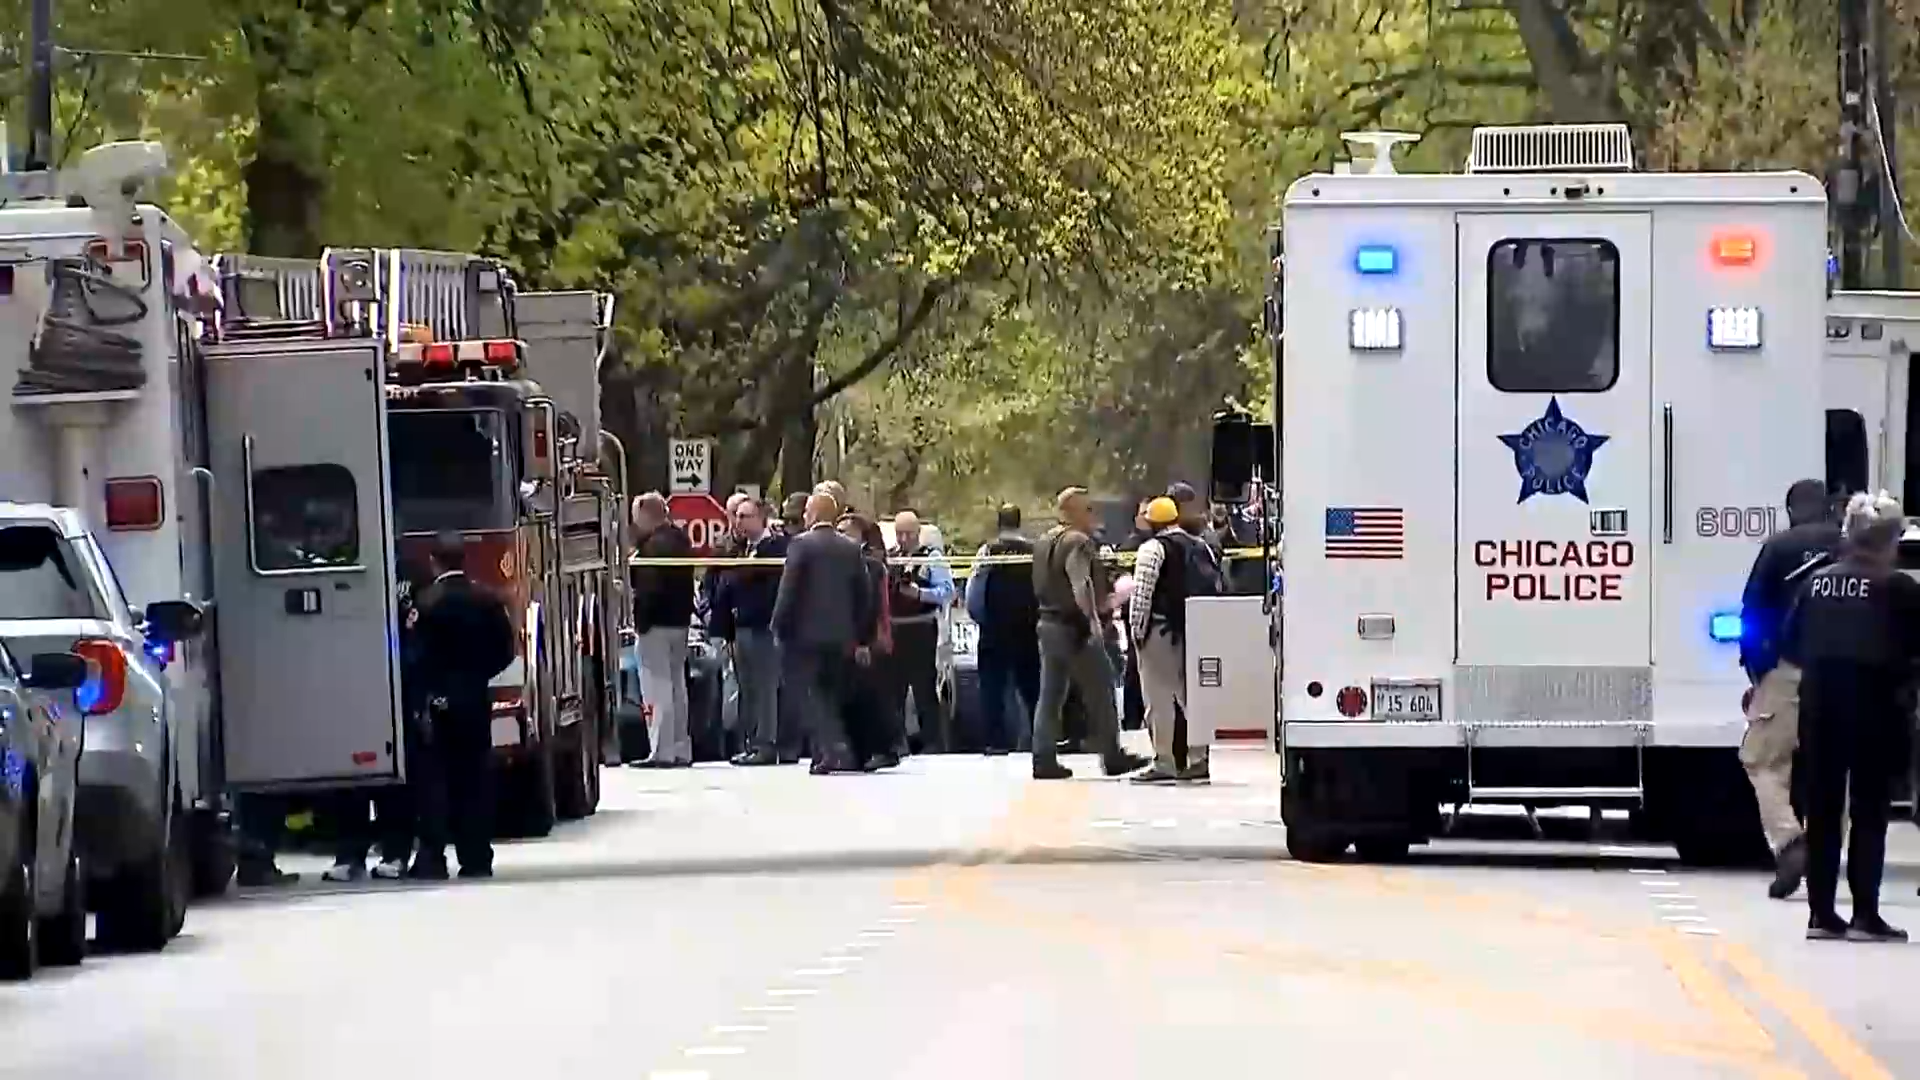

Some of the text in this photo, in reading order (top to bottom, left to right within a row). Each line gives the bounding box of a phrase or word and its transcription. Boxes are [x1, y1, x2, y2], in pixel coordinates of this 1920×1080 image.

[1519, 417, 1588, 450] CHICAGO
[674, 443, 704, 457] ONE
[674, 459, 704, 472] WAY
[1696, 507, 1776, 537] 6001
[1474, 540, 1634, 568] CHICAGO
[1485, 573, 1622, 601] POLICE
[1811, 576, 1871, 598] POLICE
[1410, 695, 1433, 712] 604
